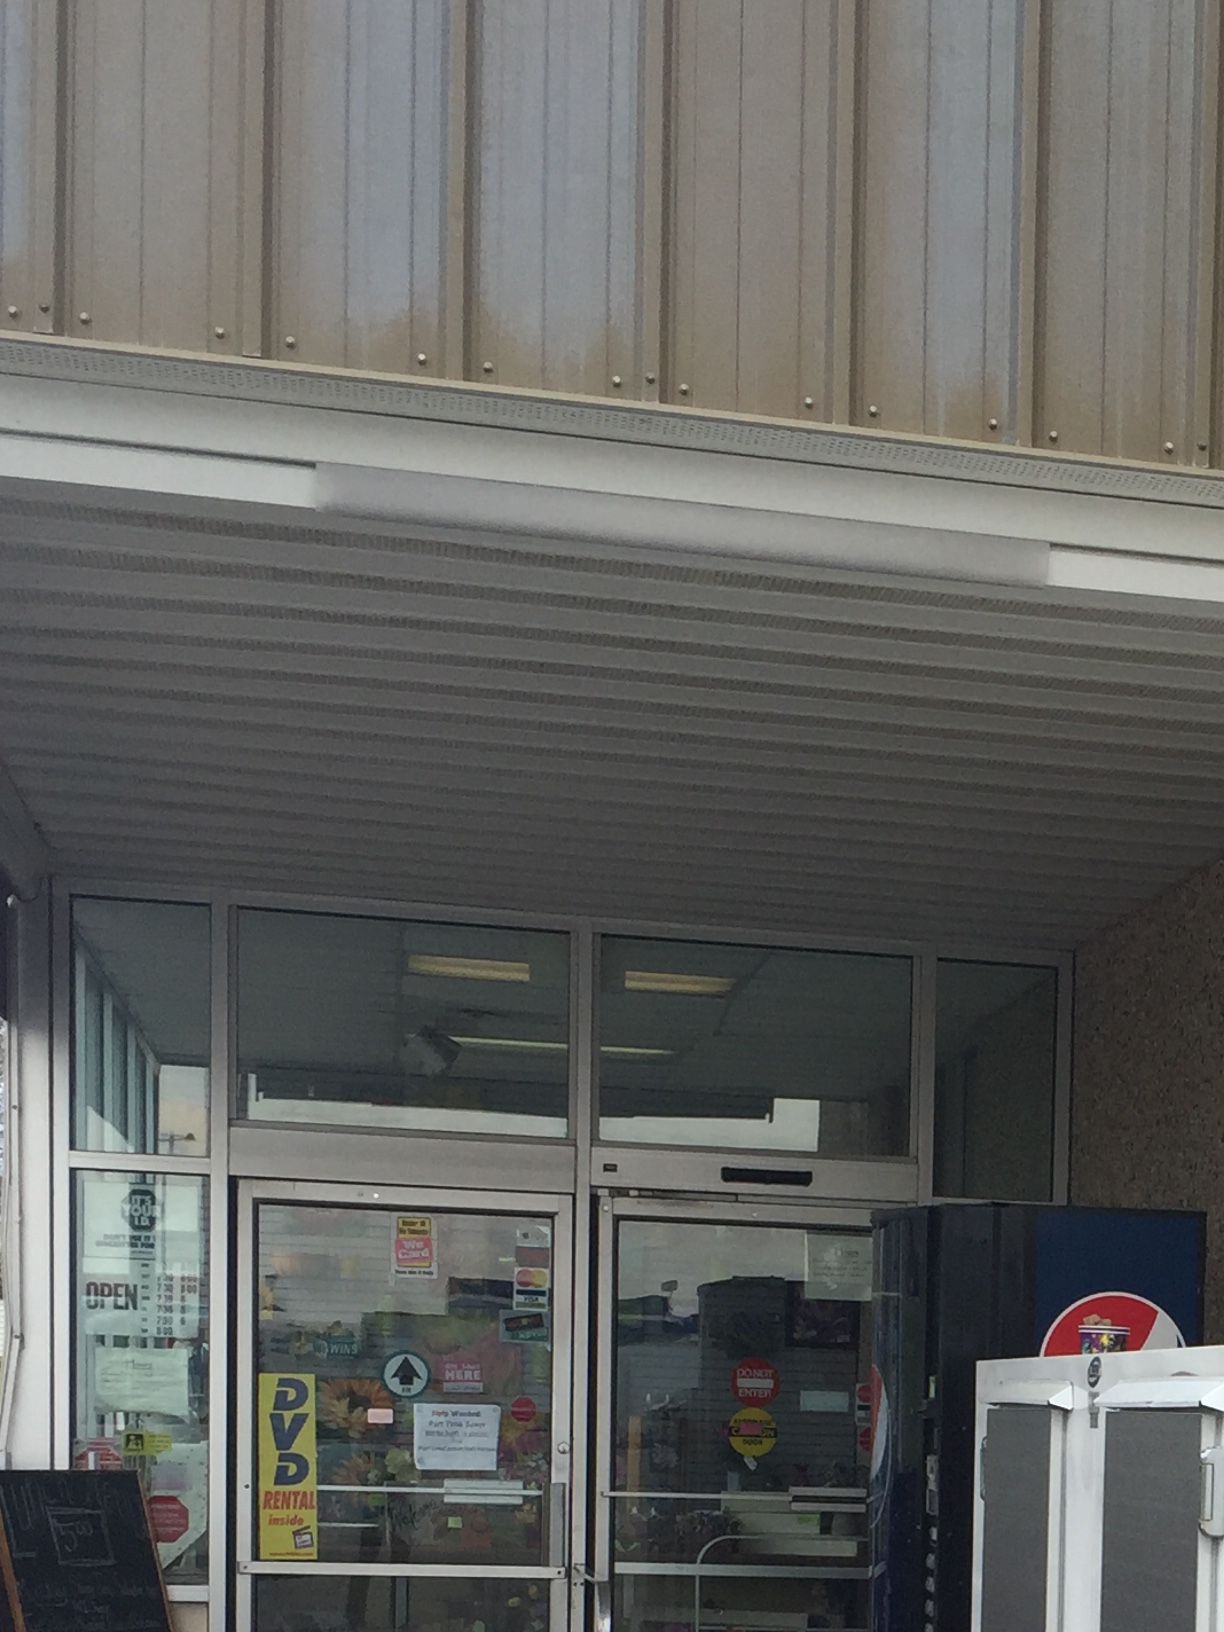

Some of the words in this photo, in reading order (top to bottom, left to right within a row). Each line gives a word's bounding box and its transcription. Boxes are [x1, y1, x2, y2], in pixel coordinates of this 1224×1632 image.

[85, 1281, 138, 1311] OPEN
[445, 1370, 481, 1380] HERE
[736, 1368, 752, 1378] DO
[753, 1368, 775, 1379] NOT
[737, 1388, 772, 1398] ENTER
[269, 1377, 310, 1486] DVD
[263, 1490, 316, 1510] RENTAL
[268, 1513, 305, 1527] inside
